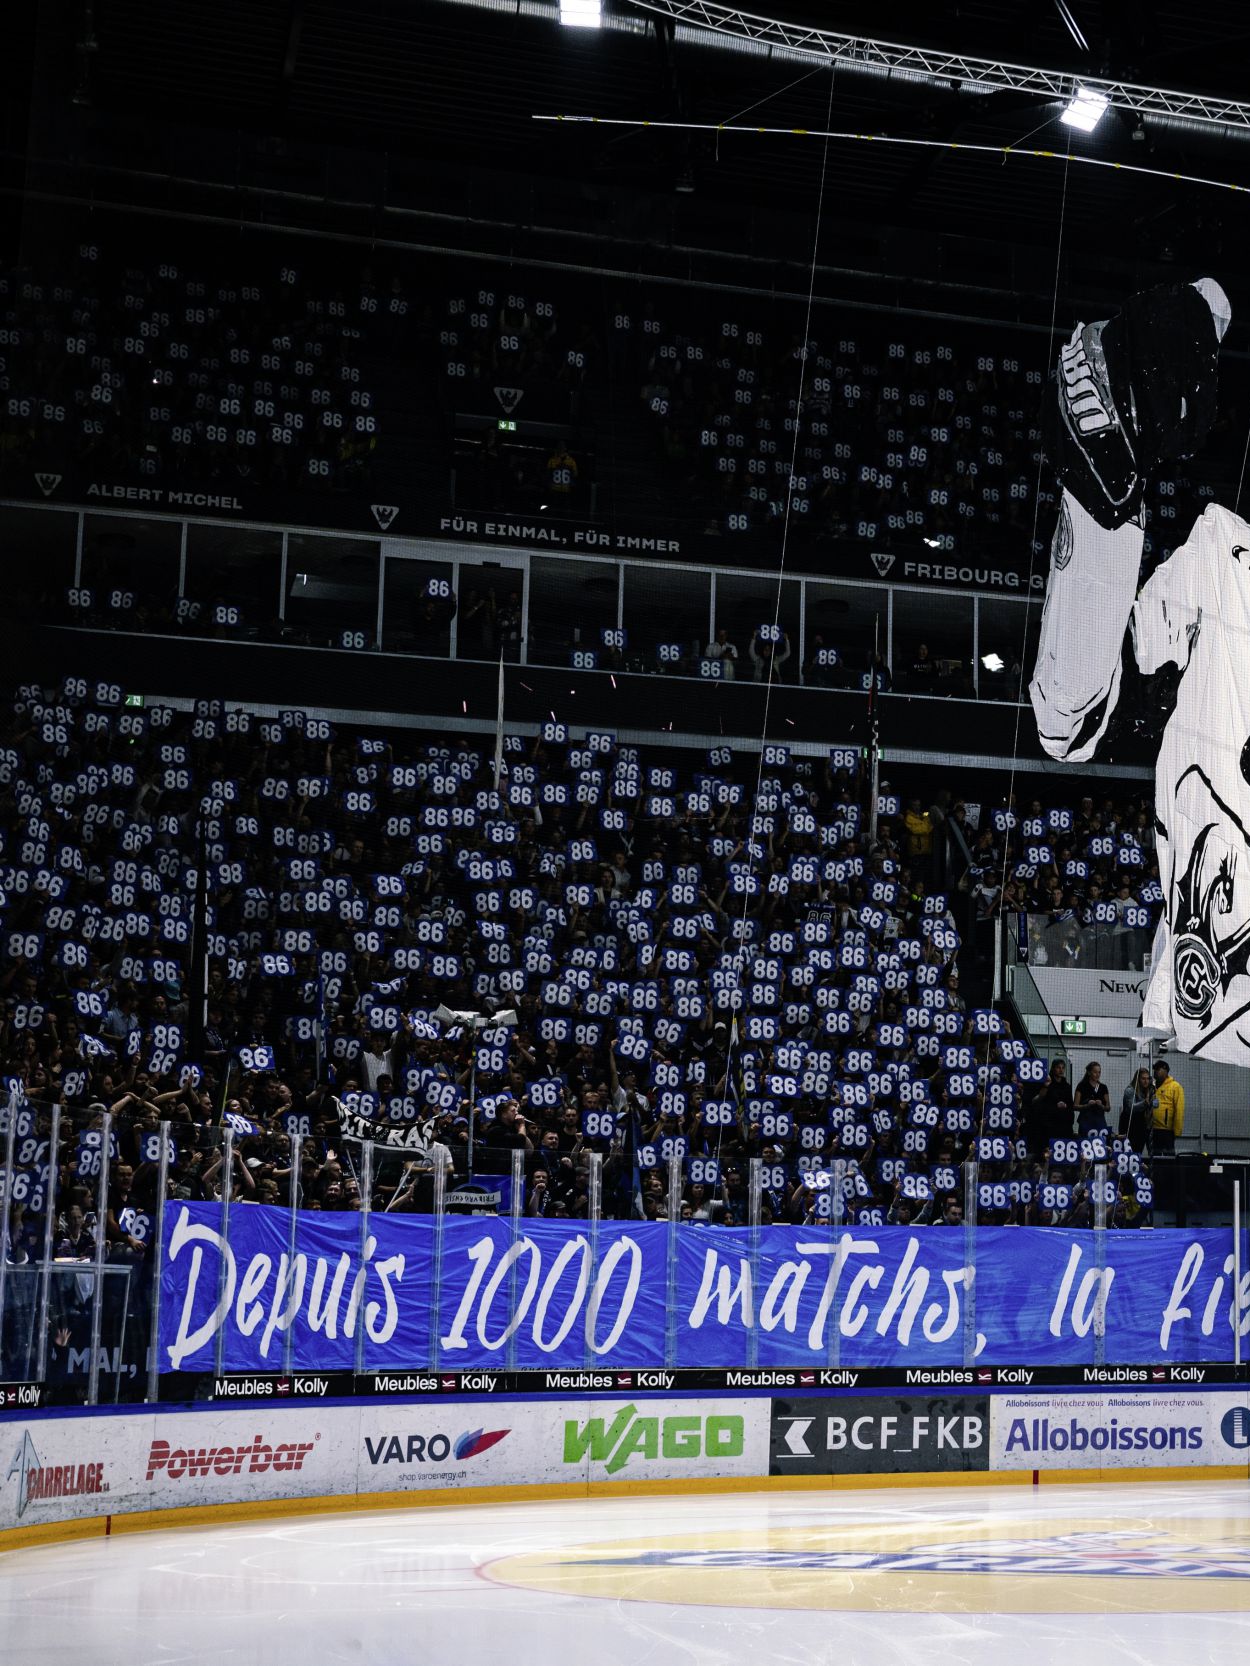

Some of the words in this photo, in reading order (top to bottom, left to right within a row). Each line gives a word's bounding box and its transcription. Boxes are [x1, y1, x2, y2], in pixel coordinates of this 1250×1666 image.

[66, 337, 87, 355] 86
[500, 335, 519, 350] 86
[843, 384, 861, 399] 86
[219, 398, 241, 415] 86
[308, 458, 329, 476] 86
[553, 468, 571, 485] 86
[87, 483, 164, 502] ALBERT
[168, 491, 244, 510] MICHEL
[440, 517, 478, 533] FÜR
[485, 522, 567, 544] EINMAL,
[574, 529, 610, 546] FÜR
[617, 535, 681, 553] IMMER
[904, 561, 1049, 590] FRIBOURG-G
[428, 578, 450, 597] 86
[215, 606, 238, 625] 86
[342, 631, 365, 649] 86
[573, 651, 595, 669] 86
[543, 723, 566, 743] 86
[765, 746, 787, 765] 86
[163, 769, 189, 790] 86
[346, 791, 371, 812] 86
[650, 797, 673, 817] 86
[871, 882, 895, 903] 86
[45, 906, 77, 931] 86
[672, 917, 698, 939] 86
[8, 933, 40, 959] 86
[283, 930, 311, 953] 86
[933, 930, 957, 949] 86
[370, 1007, 398, 1029] 86
[239, 1046, 273, 1069] 86
[847, 1050, 873, 1072] 86
[1019, 1059, 1044, 1081] 86
[530, 1082, 557, 1106] 86
[978, 1137, 1006, 1160] 86
[1053, 1140, 1078, 1163] 86
[979, 1184, 1006, 1207] 86
[169, 1207, 405, 1370] Depuis
[441, 1234, 643, 1354] 1000
[1049, 1243, 1115, 1339] la
[375, 1376, 438, 1391] Meubles
[461, 1375, 497, 1391] Kolly
[546, 1373, 612, 1388] Meubles
[637, 1373, 675, 1389] Kolly
[726, 1371, 795, 1386] Meubles
[820, 1371, 858, 1387] Kolly
[906, 1369, 973, 1383] Meubles
[997, 1369, 1034, 1385] Kolly
[1084, 1367, 1147, 1381] Meubles
[1170, 1367, 1205, 1382] Kolly
[18, 1386, 41, 1406] Kolly
[215, 1377, 273, 1396] Meubles
[294, 1378, 329, 1396] Kolly
[1006, 1399, 1050, 1408] Alloboissons
[1068, 1399, 1084, 1408] chez
[1086, 1400, 1104, 1408] vous
[1108, 1398, 1151, 1408] Alloboissons
[1153, 1398, 1168, 1408] livre
[1169, 1398, 1185, 1408] chez
[1187, 1400, 1203, 1408] vous
[563, 1403, 744, 1474] WAGO
[1005, 1418, 1203, 1452] Alloboissons
[146, 1434, 314, 1481] Powerbar
[365, 1434, 451, 1465] VARO
[27, 1461, 104, 1500] CARRELAGE
